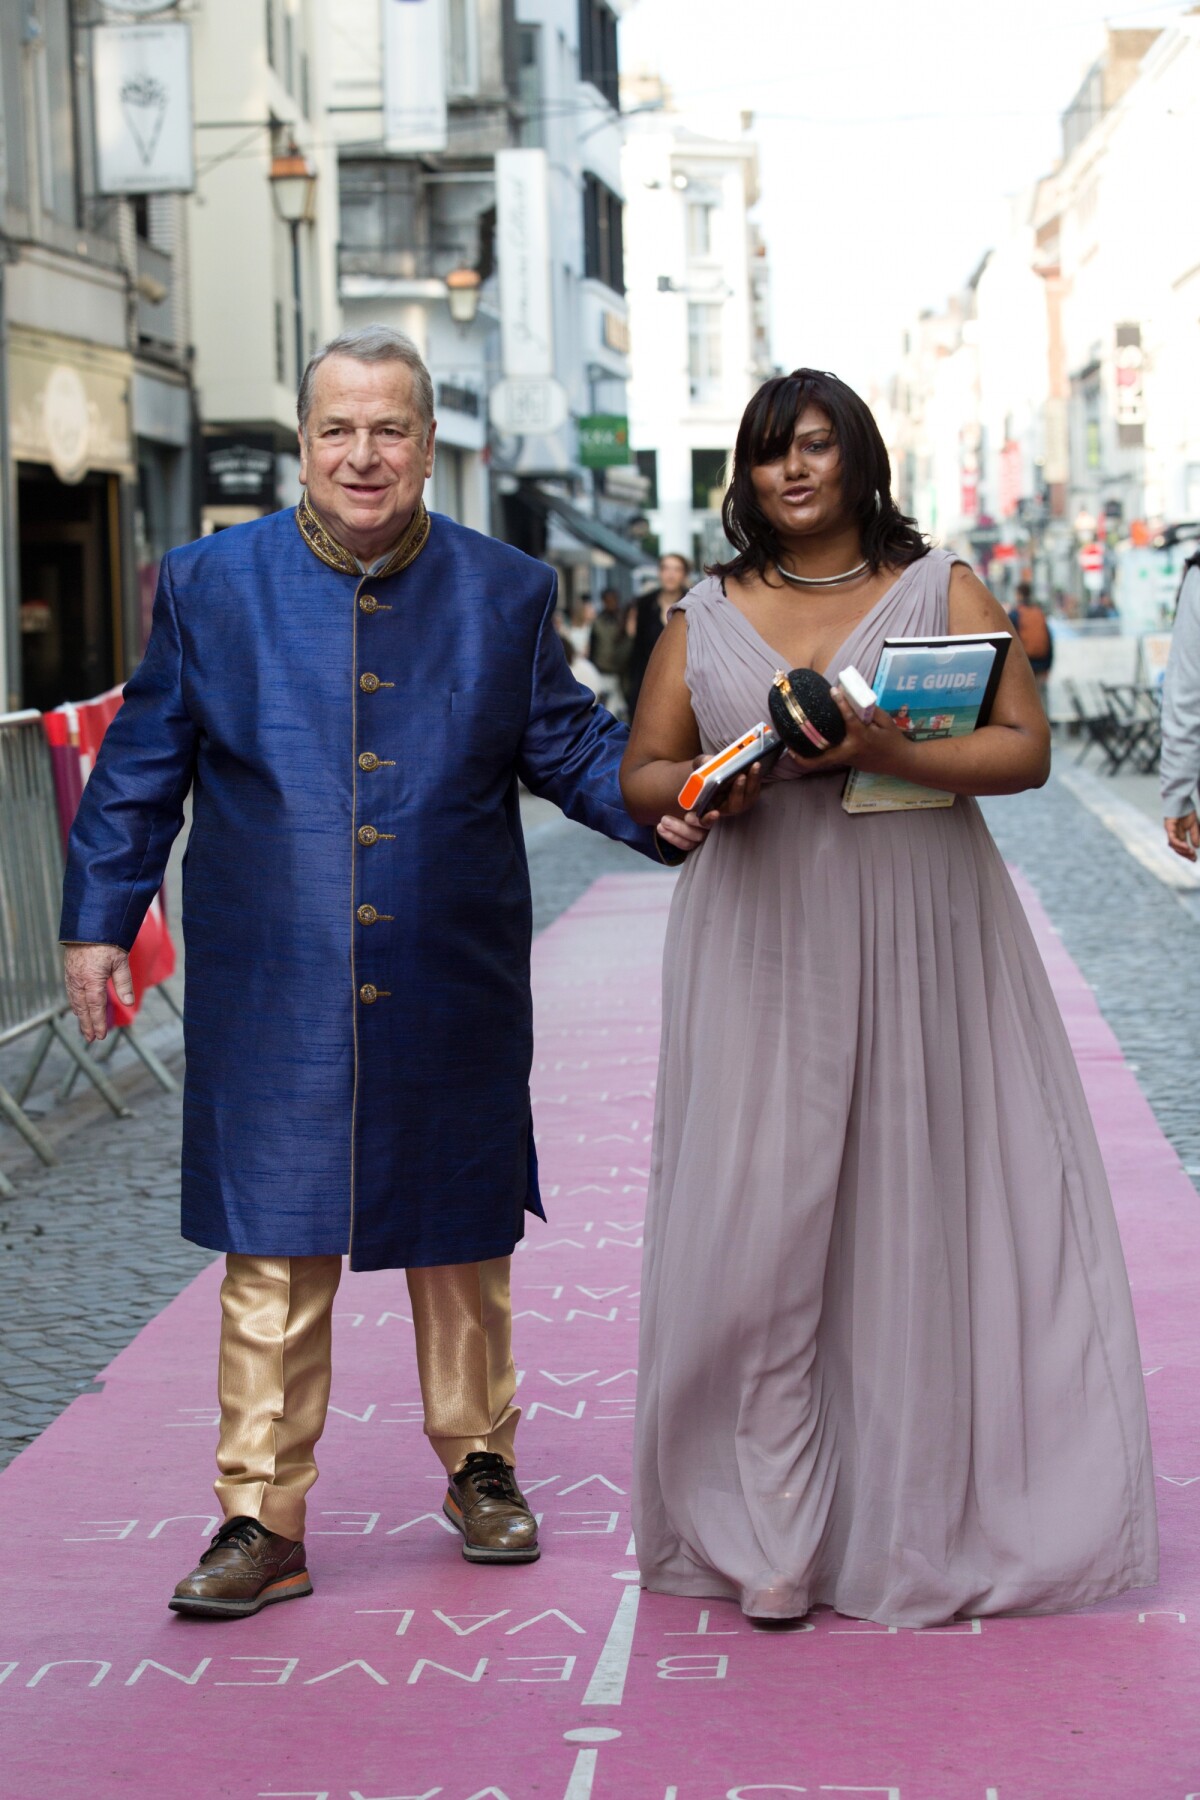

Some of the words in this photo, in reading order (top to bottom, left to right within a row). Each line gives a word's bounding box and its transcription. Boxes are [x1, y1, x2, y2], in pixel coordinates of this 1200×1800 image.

[896, 675, 918, 691] LE
[922, 672, 977, 689] GUIDE
[425, 1474, 627, 1496] VA
[0, 1655, 577, 1690] ENVENU
